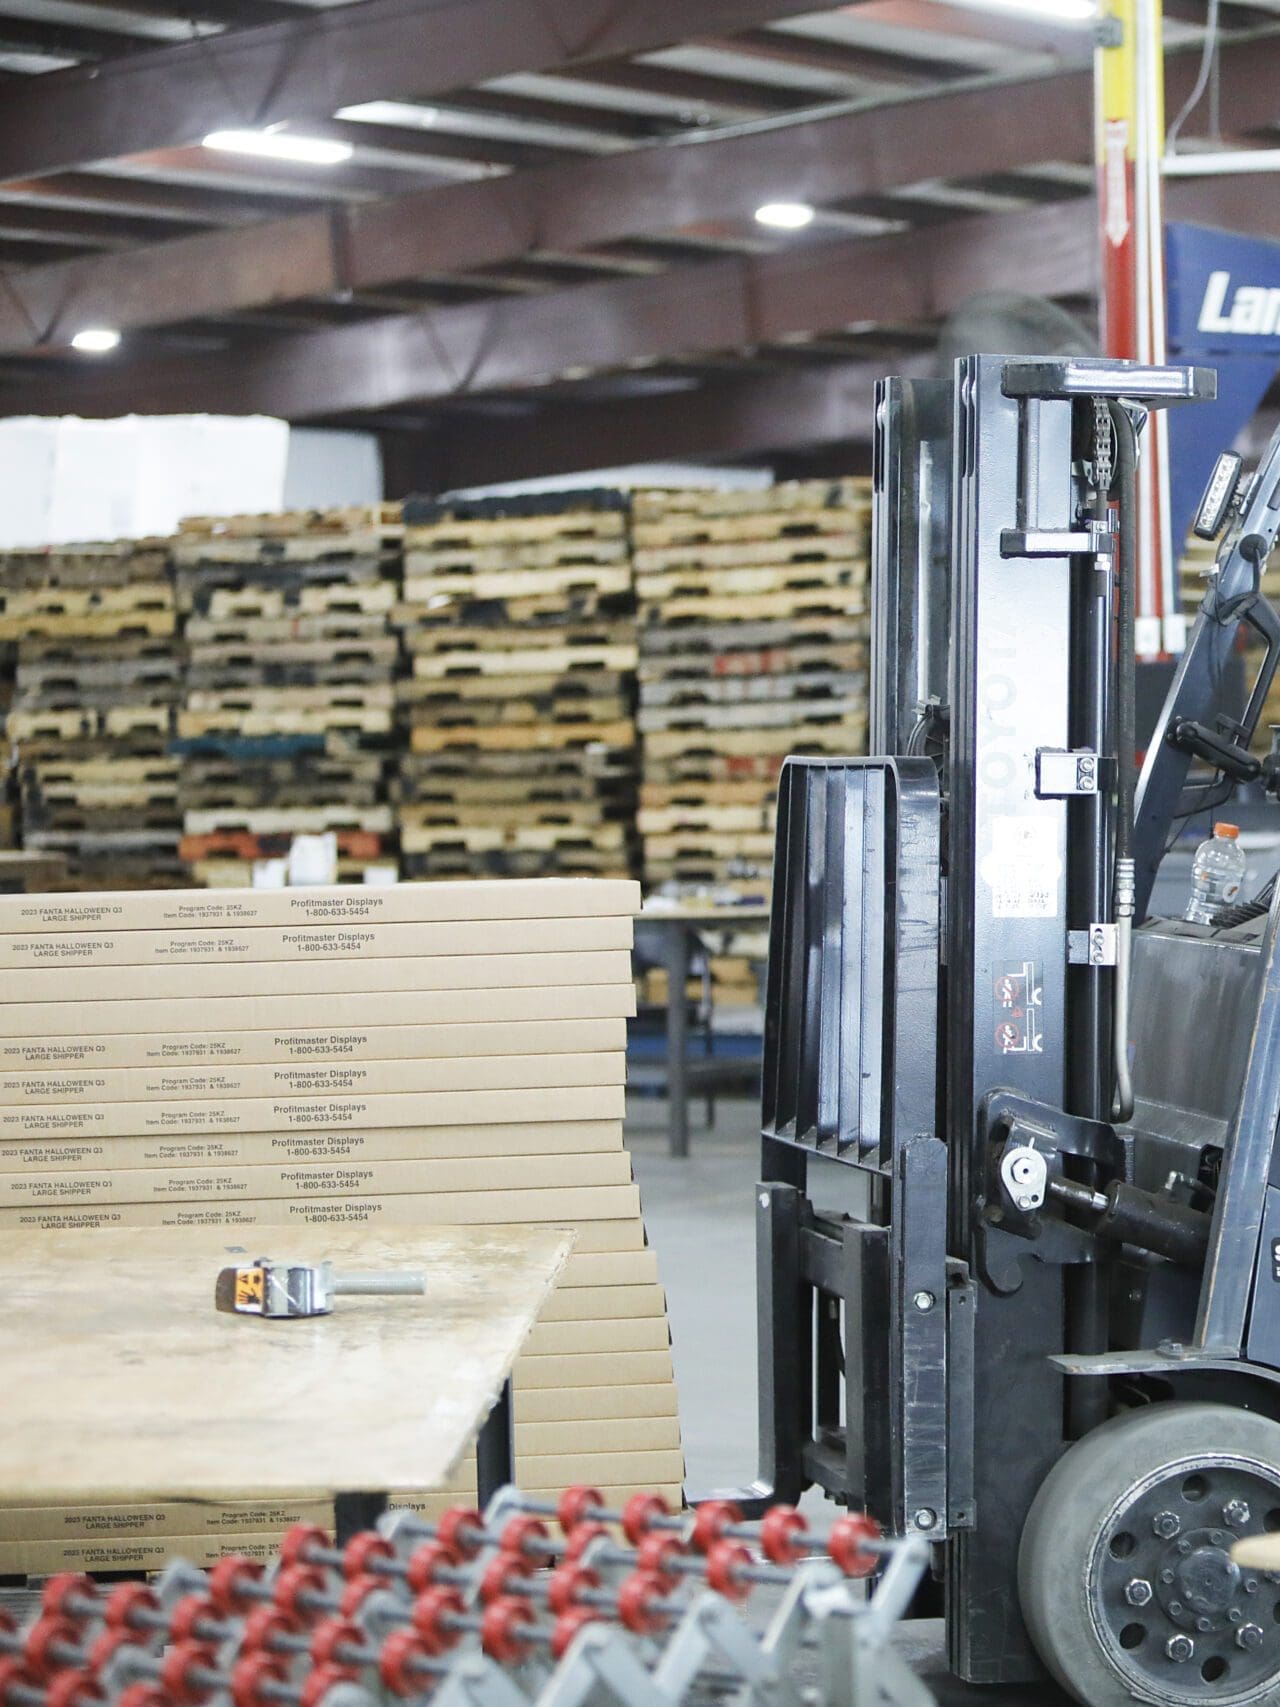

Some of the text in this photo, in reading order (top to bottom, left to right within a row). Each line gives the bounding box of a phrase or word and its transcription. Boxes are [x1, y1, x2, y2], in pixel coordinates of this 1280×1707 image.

[290, 897, 383, 908] Profitmaster Displays
[305, 908, 369, 916] 1-800-633-5454
[42, 914, 70, 922] LARGE
[282, 932, 375, 943] Profitmaster Displays
[297, 942, 361, 952] 1-800-633-5454
[34, 950, 62, 958] LARGE
[274, 1035, 367, 1046] Profitmaster Displays
[289, 1046, 353, 1054] 1-800-633-5454
[54, 1052, 84, 1060] SHIPPER
[274, 1069, 367, 1080] Profitmaster Displays
[289, 1080, 353, 1088] 1-800-633-5454
[54, 1086, 84, 1094] SHIPPER
[273, 1103, 366, 1114] Profitmaster Displays
[288, 1114, 352, 1122] 1-800-633-5454
[52, 1120, 84, 1128] SHIPPER
[272, 1136, 365, 1147] Profitmaster Displays
[287, 1146, 351, 1156] 1-800-633-5454
[52, 1154, 82, 1162] SHIPPER
[281, 1170, 374, 1181] Profitmaster Displays
[296, 1180, 360, 1190] 1-800-633-5454
[32, 1188, 60, 1196] LARGE
[289, 1203, 382, 1214] Profitmaster Displays
[63, 1214, 110, 1222] HALLOWEEN
[304, 1214, 368, 1222] 1-800-633-5454
